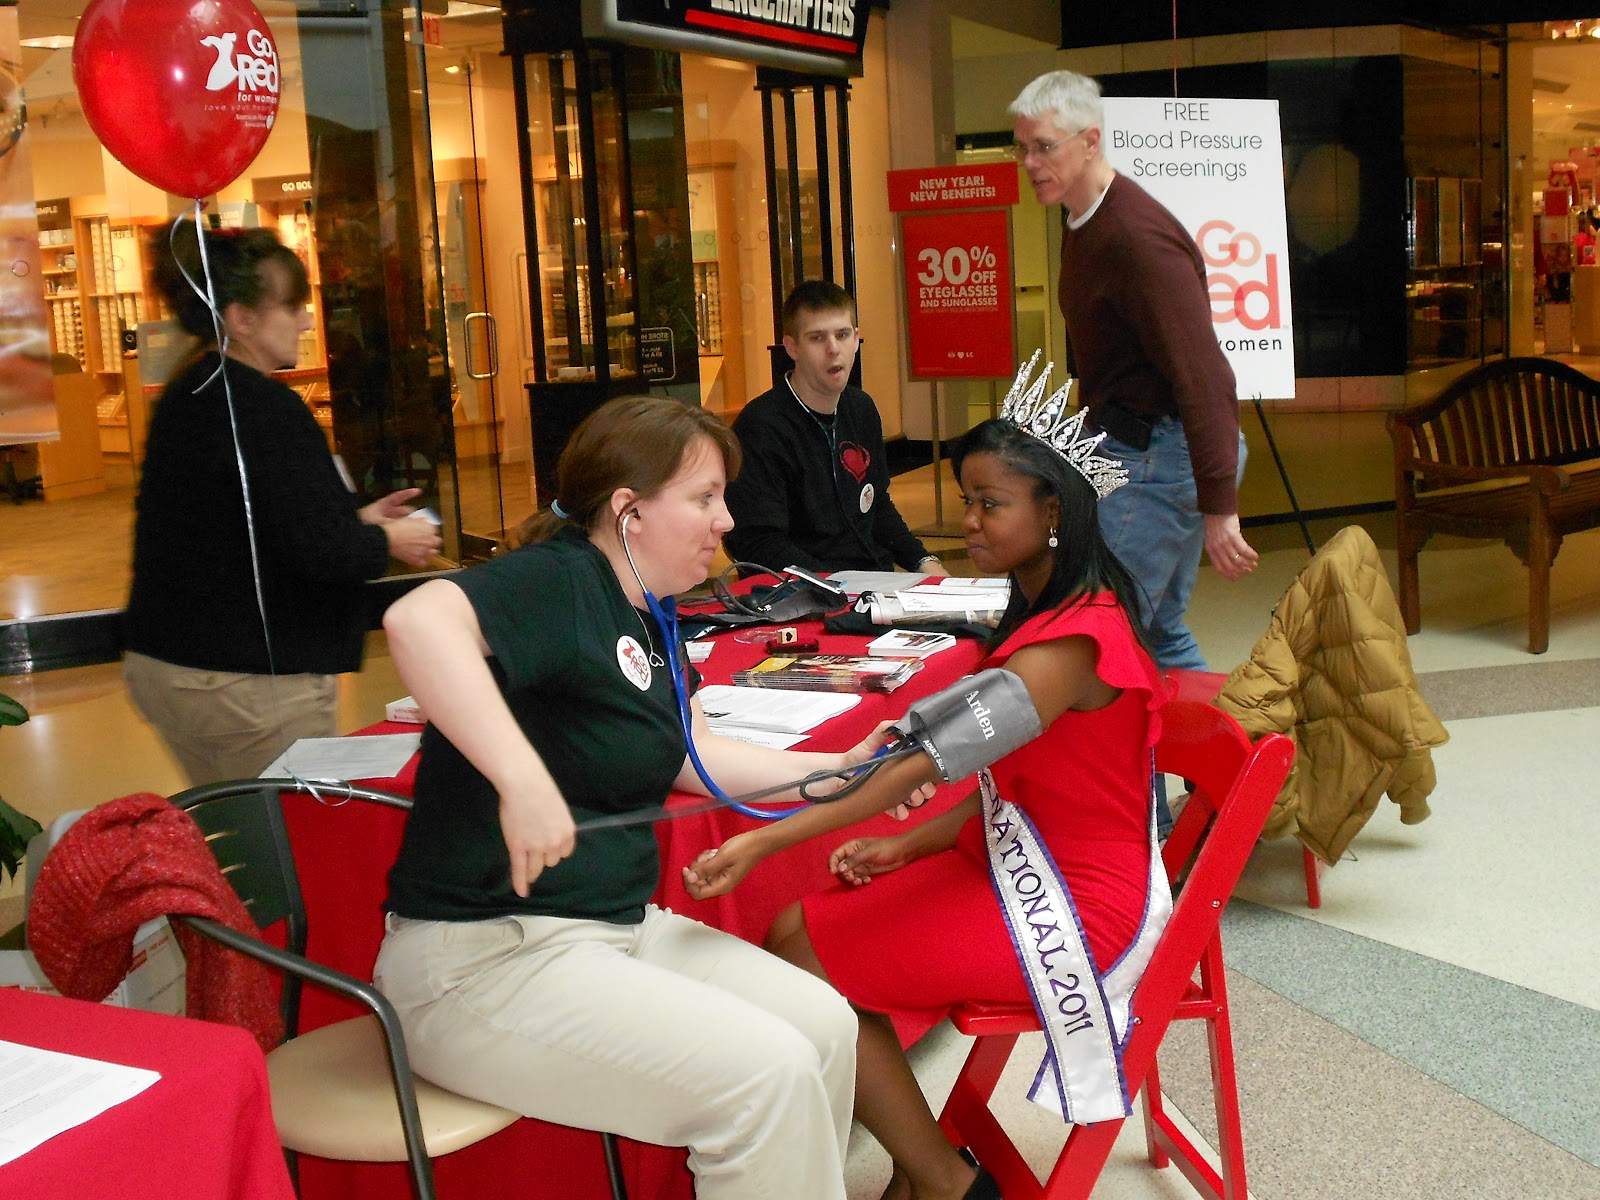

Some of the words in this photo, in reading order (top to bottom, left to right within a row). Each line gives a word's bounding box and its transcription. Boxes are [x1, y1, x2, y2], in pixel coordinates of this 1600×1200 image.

[246, 29, 272, 57] Go
[236, 51, 278, 92] Red
[237, 92, 251, 102] for
[1164, 102, 1210, 121] FREE
[1113, 130, 1173, 148] Blood
[1180, 131, 1263, 149] Pressure
[1133, 158, 1247, 181] Screenings
[282, 182, 295, 191] GO
[296, 180, 312, 190] BOL
[920, 178, 947, 189] NEW
[951, 175, 984, 187] YEAR!
[910, 190, 938, 202] NEW
[941, 186, 996, 200] BENEFITS!
[1195, 219, 1262, 268] Go
[917, 245, 996, 286] 30%
[970, 270, 997, 284] OFF
[920, 285, 998, 298] EYEGLASSES
[1207, 253, 1281, 331] ed
[920, 299, 939, 307] AND
[942, 297, 998, 307] SUNGLASSES
[964, 690, 995, 740] Arden
[923, 739, 940, 758] ADULT
[1049, 973, 1094, 1036] 2011
